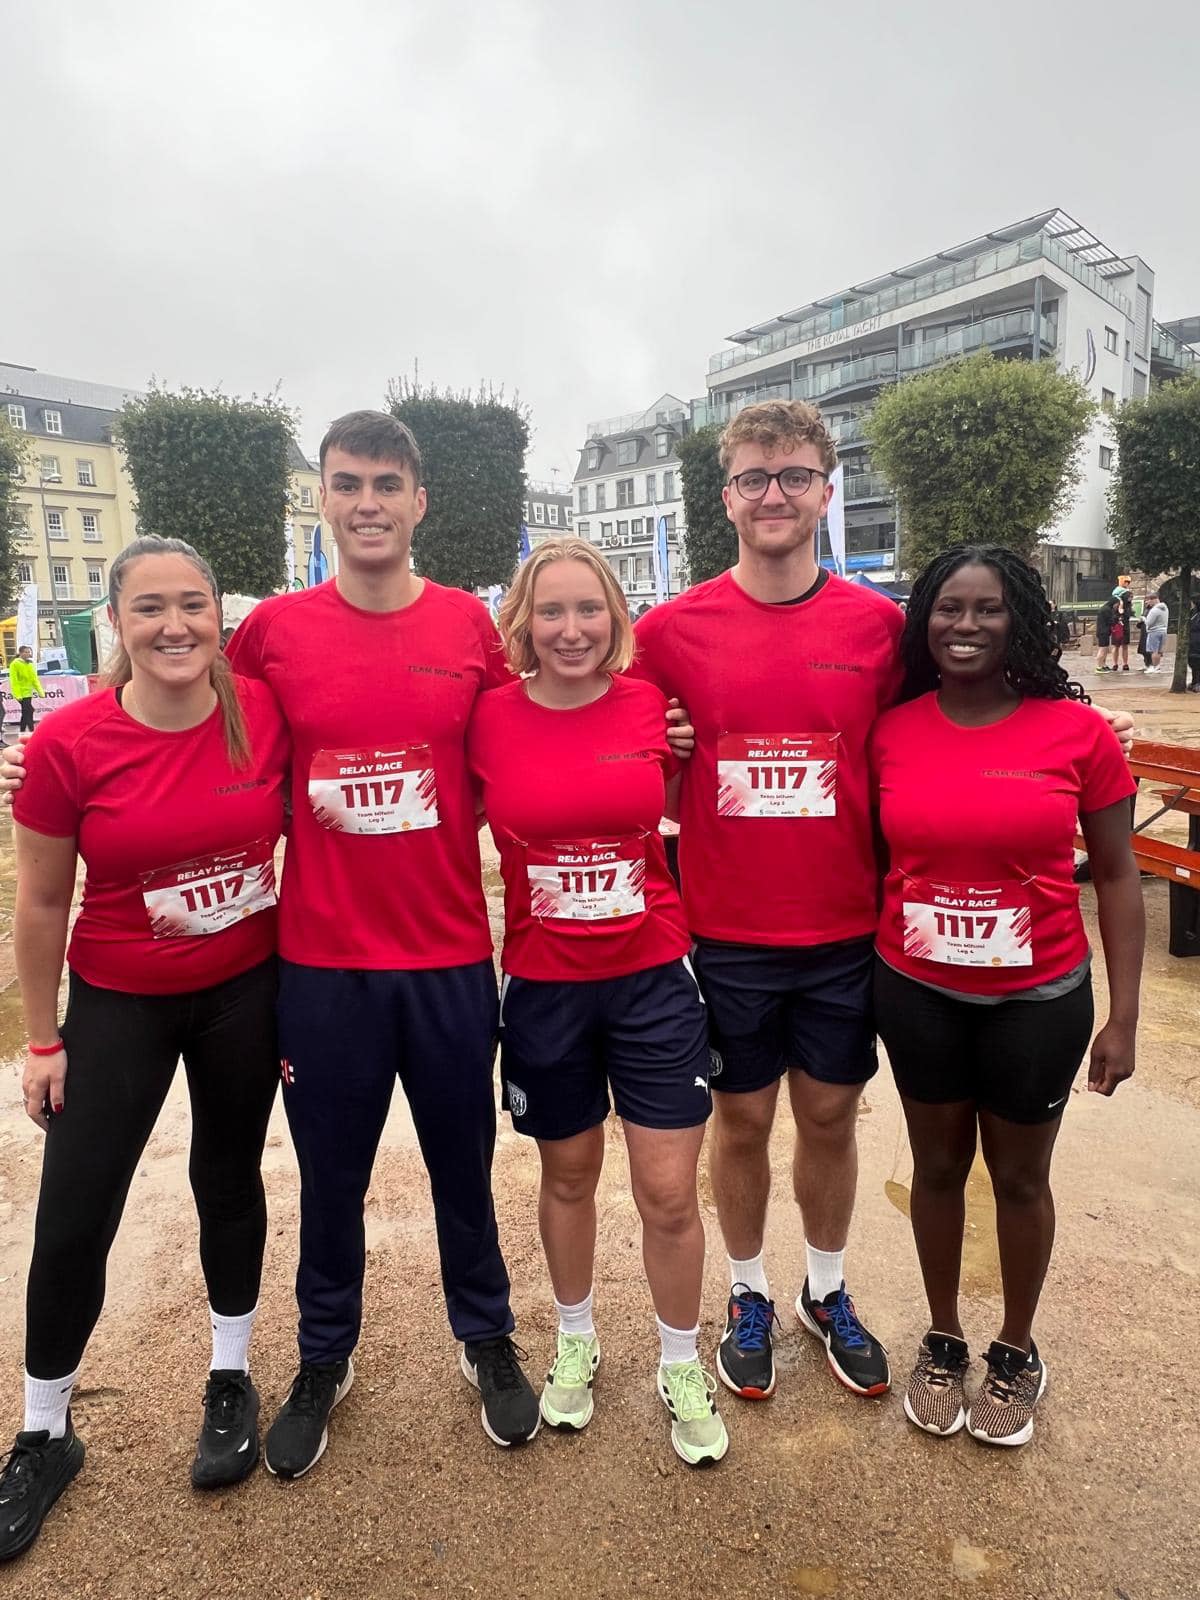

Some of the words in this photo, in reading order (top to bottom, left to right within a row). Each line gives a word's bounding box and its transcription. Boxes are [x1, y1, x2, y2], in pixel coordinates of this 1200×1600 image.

[807, 336, 821, 352] THE
[823, 327, 850, 346] ROYAL
[853, 316, 881, 337] YACHT
[0, 689, 65, 700] Rasroft
[748, 750, 780, 758] RELAY
[340, 764, 373, 775] RELAY
[376, 761, 403, 771] RACE
[747, 767, 807, 789] 1117
[340, 779, 404, 808] 1117
[558, 855, 590, 863] RELAY
[592, 852, 616, 862] RACE
[177, 867, 212, 881] RELAY
[214, 862, 244, 873] RACE
[558, 868, 617, 893] 1117
[180, 875, 245, 913] 1117
[934, 896, 966, 907] RELAY
[968, 899, 998, 907] RACE
[934, 912, 998, 939] 1117
